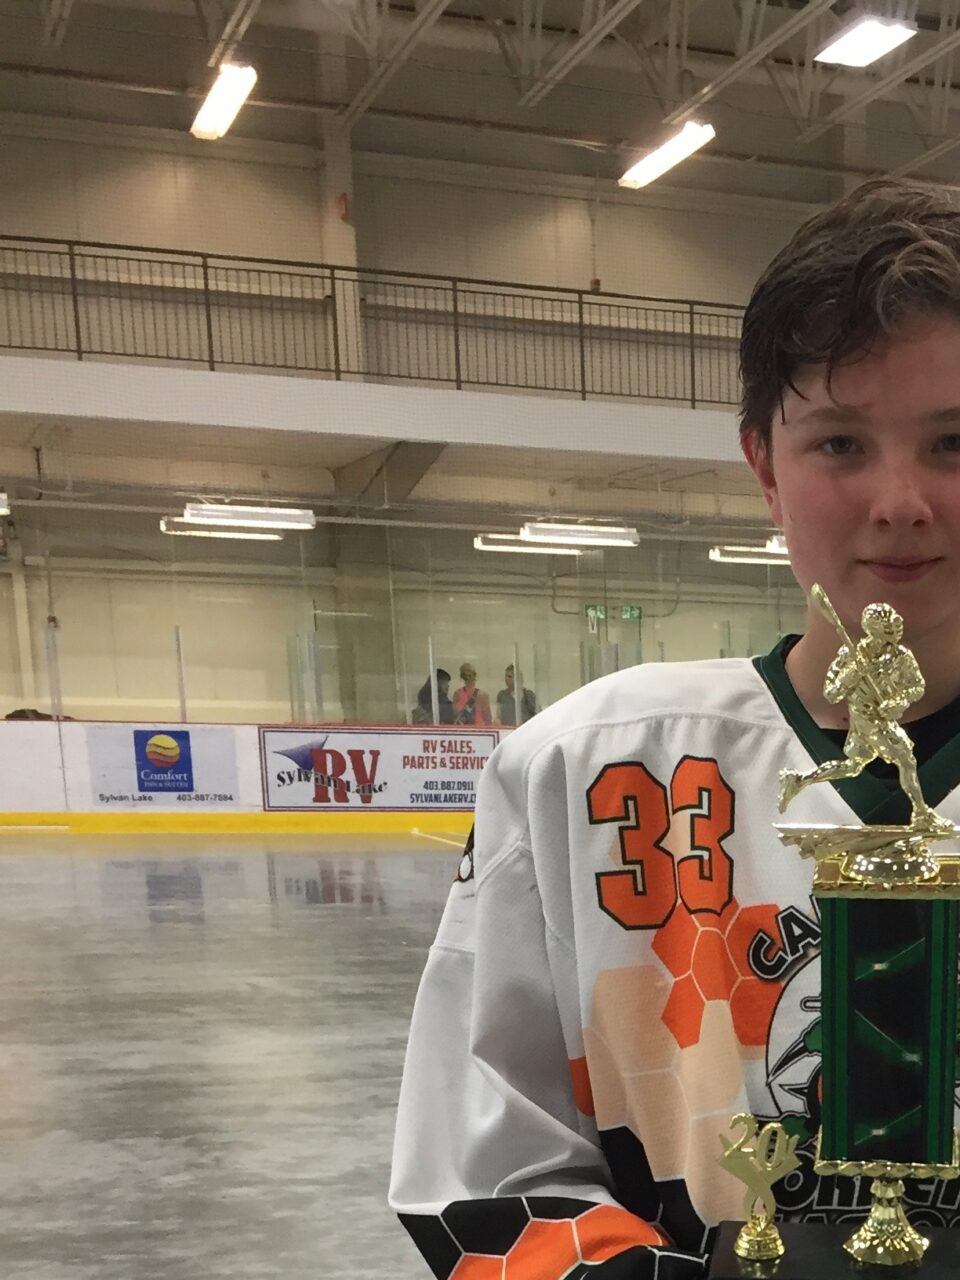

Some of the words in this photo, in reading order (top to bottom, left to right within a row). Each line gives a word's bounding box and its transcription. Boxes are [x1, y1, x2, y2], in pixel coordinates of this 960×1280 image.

[422, 739, 438, 754] RV
[402, 755, 438, 769] PARTS
[439, 757, 447, 768] &
[449, 756, 489, 770] SERVIC
[140, 769, 188, 781] Comfort
[310, 748, 381, 804] RV
[98, 793, 129, 803] Sylvan
[131, 793, 153, 802] Lake
[409, 792, 477, 804] SYLVANLAKERV.C
[586, 755, 736, 930] 33
